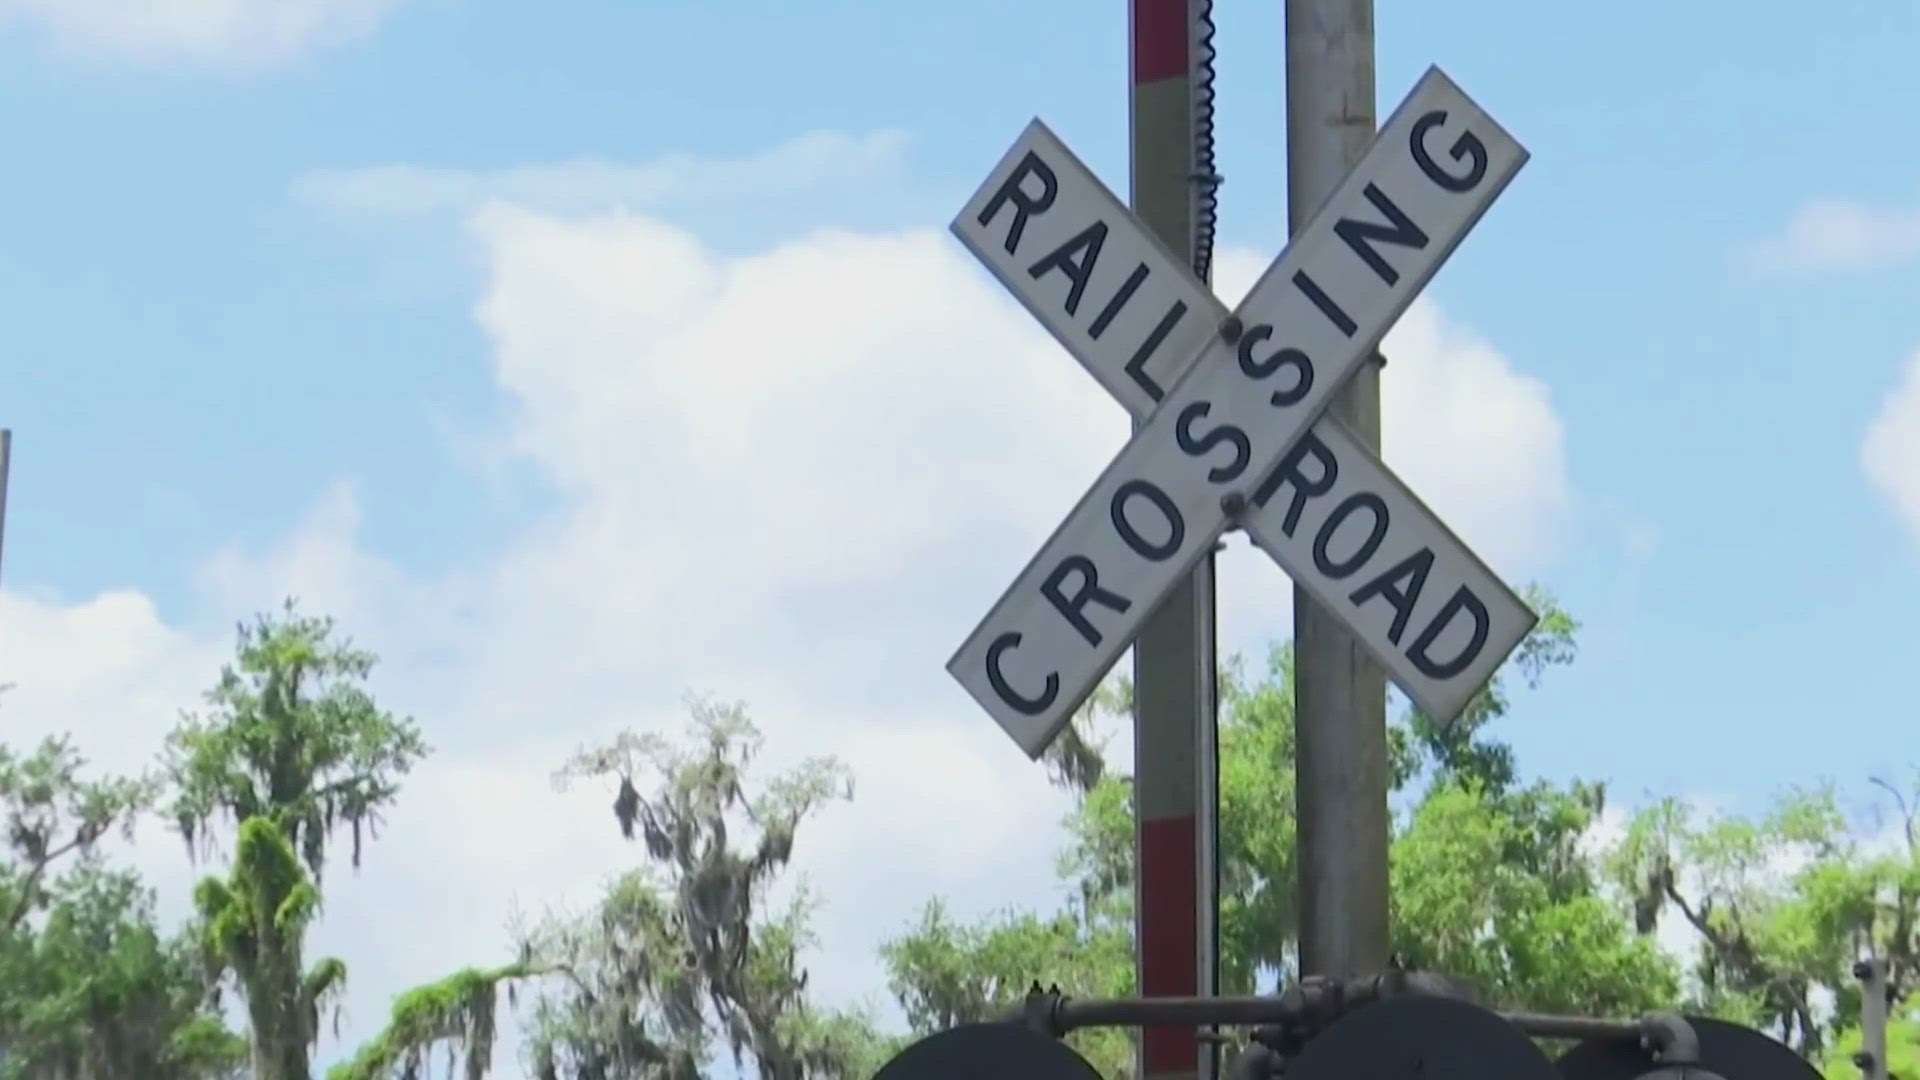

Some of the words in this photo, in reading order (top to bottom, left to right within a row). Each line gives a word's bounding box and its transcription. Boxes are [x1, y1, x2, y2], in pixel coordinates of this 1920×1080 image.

[976, 149, 1188, 402] RAIL
[1250, 430, 1491, 681] ROAD
[985, 109, 1489, 716] CROSSING
